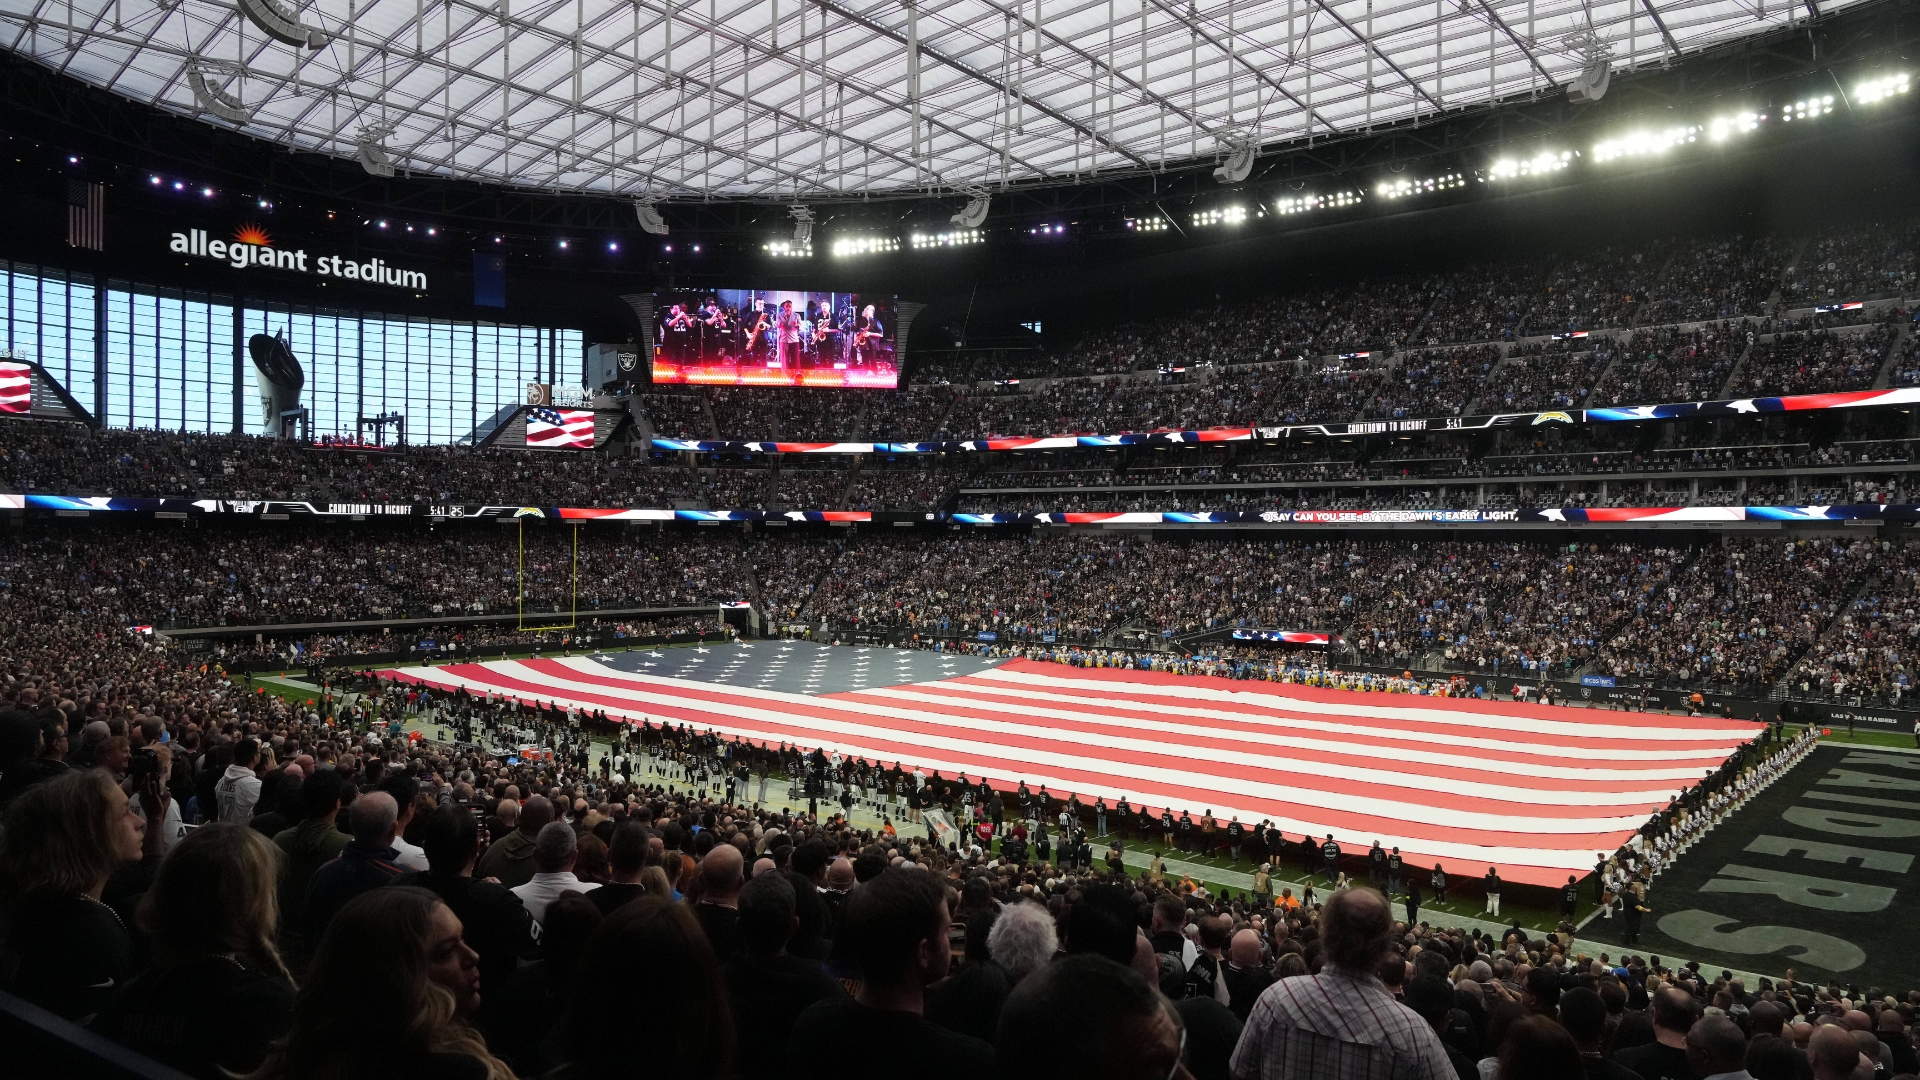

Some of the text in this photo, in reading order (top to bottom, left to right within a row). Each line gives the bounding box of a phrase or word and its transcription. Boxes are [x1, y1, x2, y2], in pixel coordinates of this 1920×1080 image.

[170, 228, 426, 290] allegiant stadium
[552, 384, 593, 400] MGM
[552, 399, 594, 408] RESORTS
[1347, 418, 1462, 434] COUNTDOWN TO KICKOFF 5:41
[328, 503, 462, 517] COUNTDOWN TO KICKOFF 5:41 25
[1272, 512, 1291, 521] SAY
[1293, 512, 1314, 521] CAN
[1315, 512, 1336, 521] YOU
[1362, 512, 1377, 521] BY
[1380, 512, 1400, 521] THE
[1400, 511, 1443, 521] DAWN'S
[1445, 510, 1480, 520] EARLY
[1482, 510, 1519, 522] LIGHT,
[1868, 716, 1897, 724] RAIDERS
[1118, 808, 1127, 816] 75
[1181, 821, 1190, 830] 75
